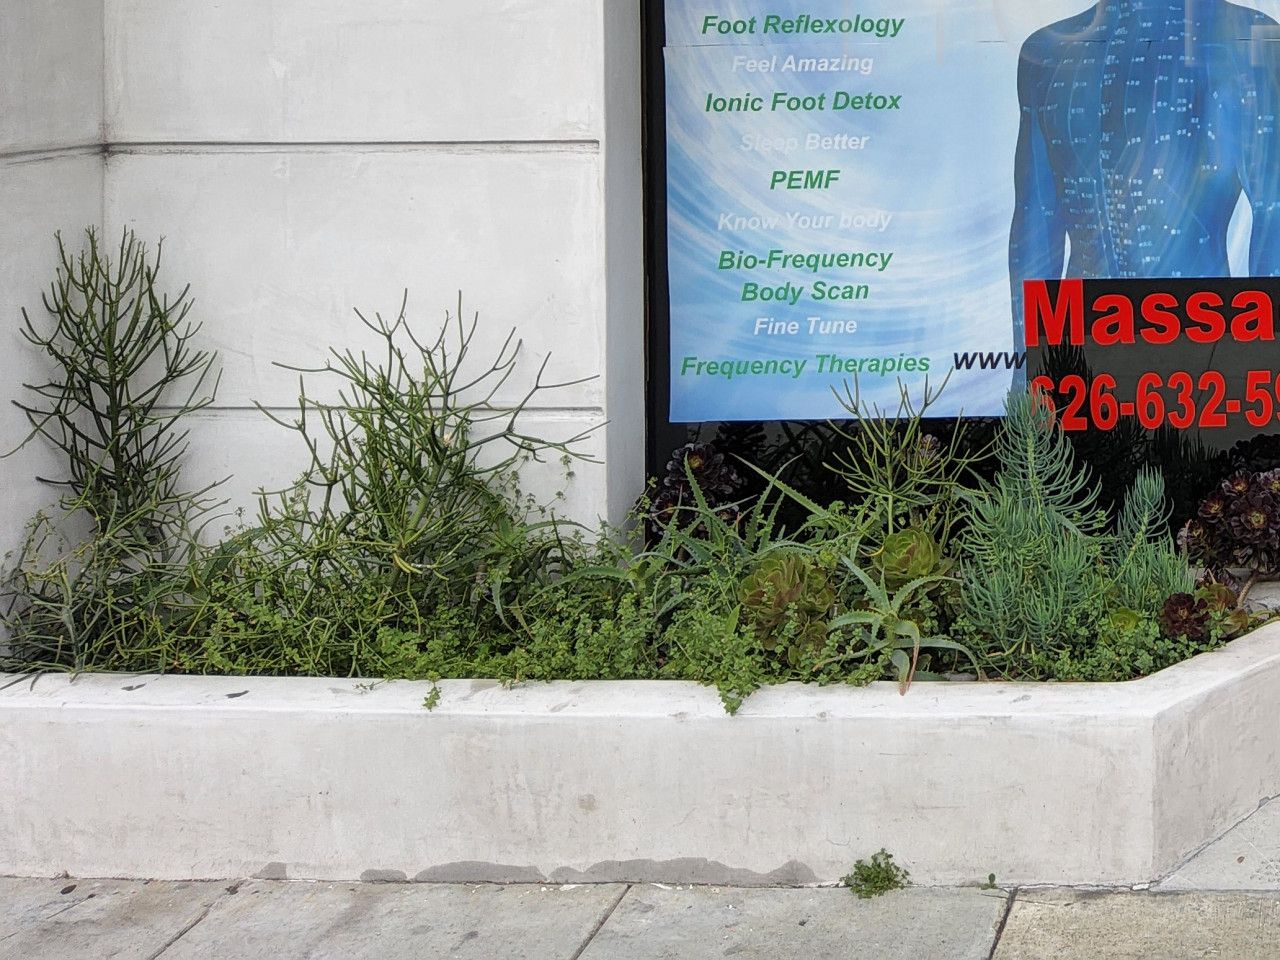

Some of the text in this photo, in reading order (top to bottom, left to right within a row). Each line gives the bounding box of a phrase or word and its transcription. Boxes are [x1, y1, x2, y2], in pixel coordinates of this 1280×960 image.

[702, 15, 905, 37] Foot Reflexology
[732, 55, 874, 74] Feel Amazing
[705, 92, 902, 112] Ionic Foot Detox
[740, 133, 870, 155] Sleep Better
[770, 169, 840, 190] PEMF
[717, 212, 892, 232] Know Your body
[718, 249, 893, 272] Bio-Frequency
[741, 281, 869, 305] Body Scan
[753, 317, 857, 335] Fine Tune
[681, 353, 931, 379] Frequency Therapies
[953, 351, 1028, 370] www
